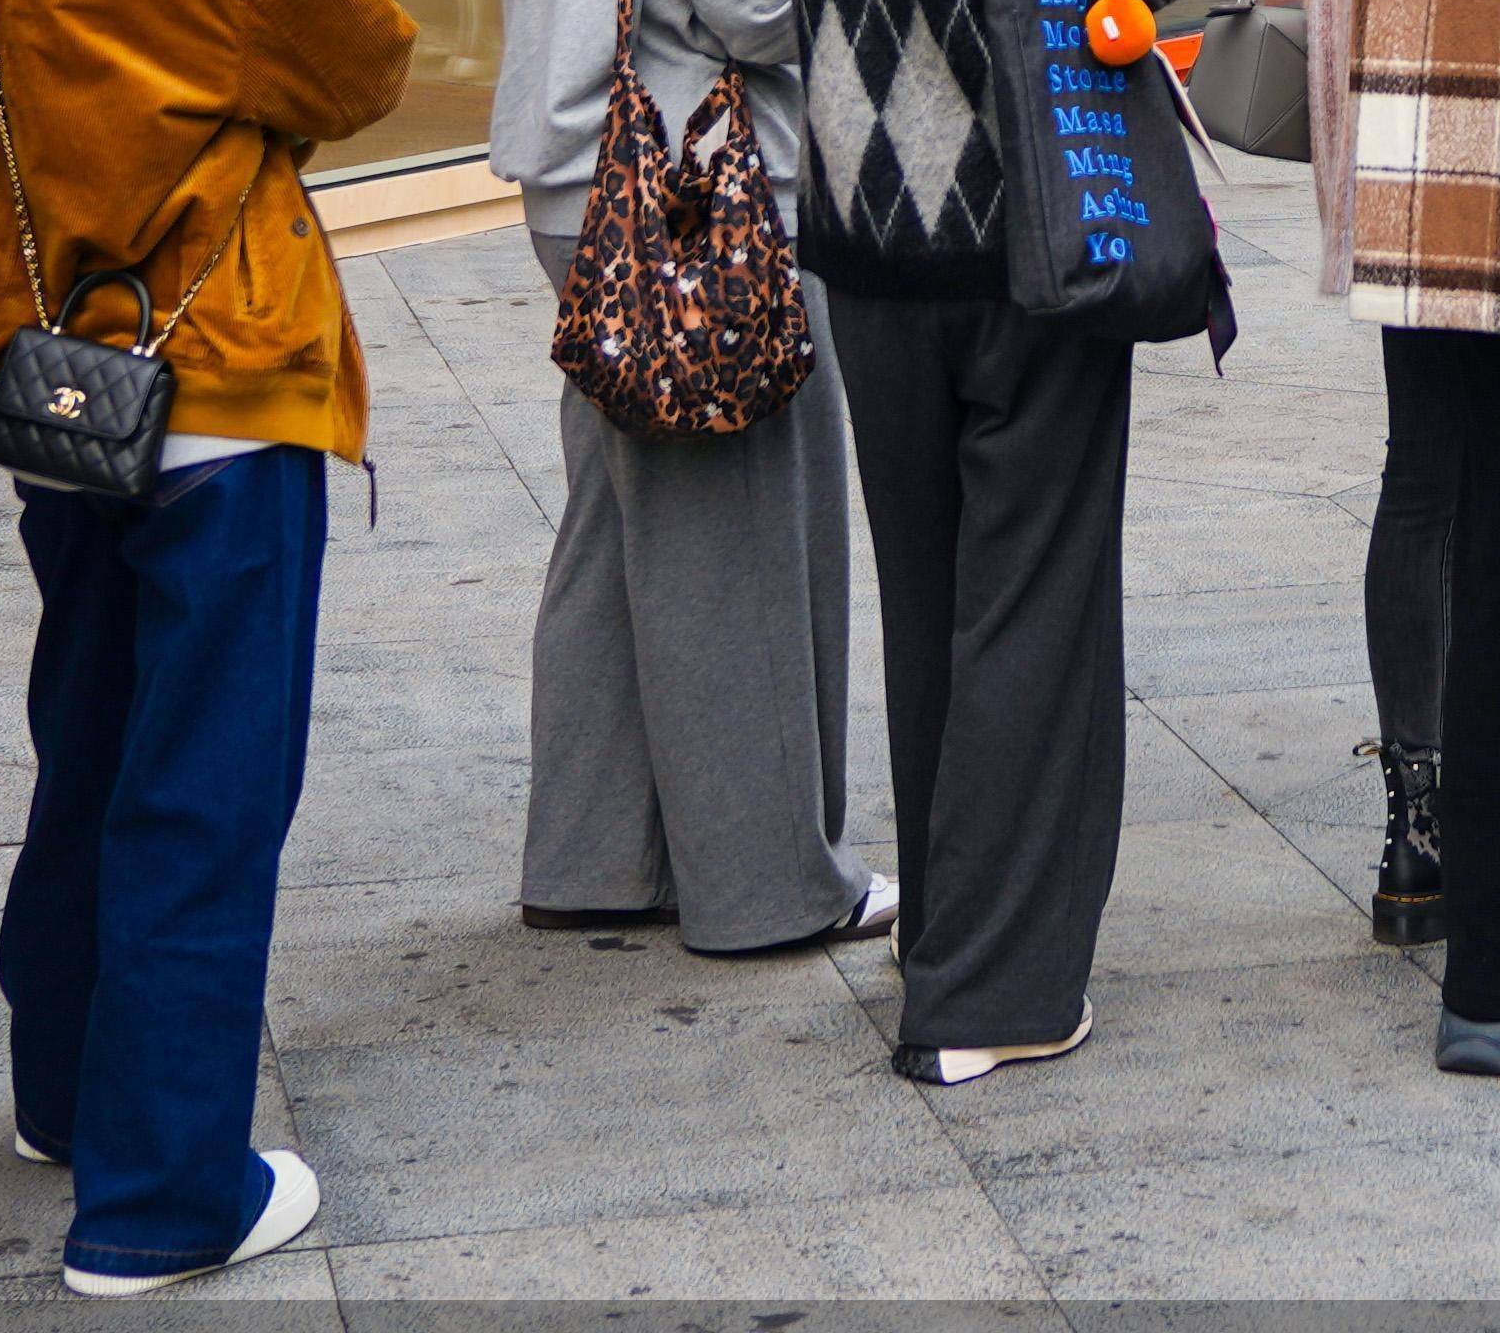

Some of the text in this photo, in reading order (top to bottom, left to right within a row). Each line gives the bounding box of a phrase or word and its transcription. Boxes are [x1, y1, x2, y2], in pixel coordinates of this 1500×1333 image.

[1047, 63, 1128, 94] Stone
[1052, 105, 1128, 138] Masa
[1063, 147, 1135, 186] Ming
[1080, 187, 1151, 225] Ashin
